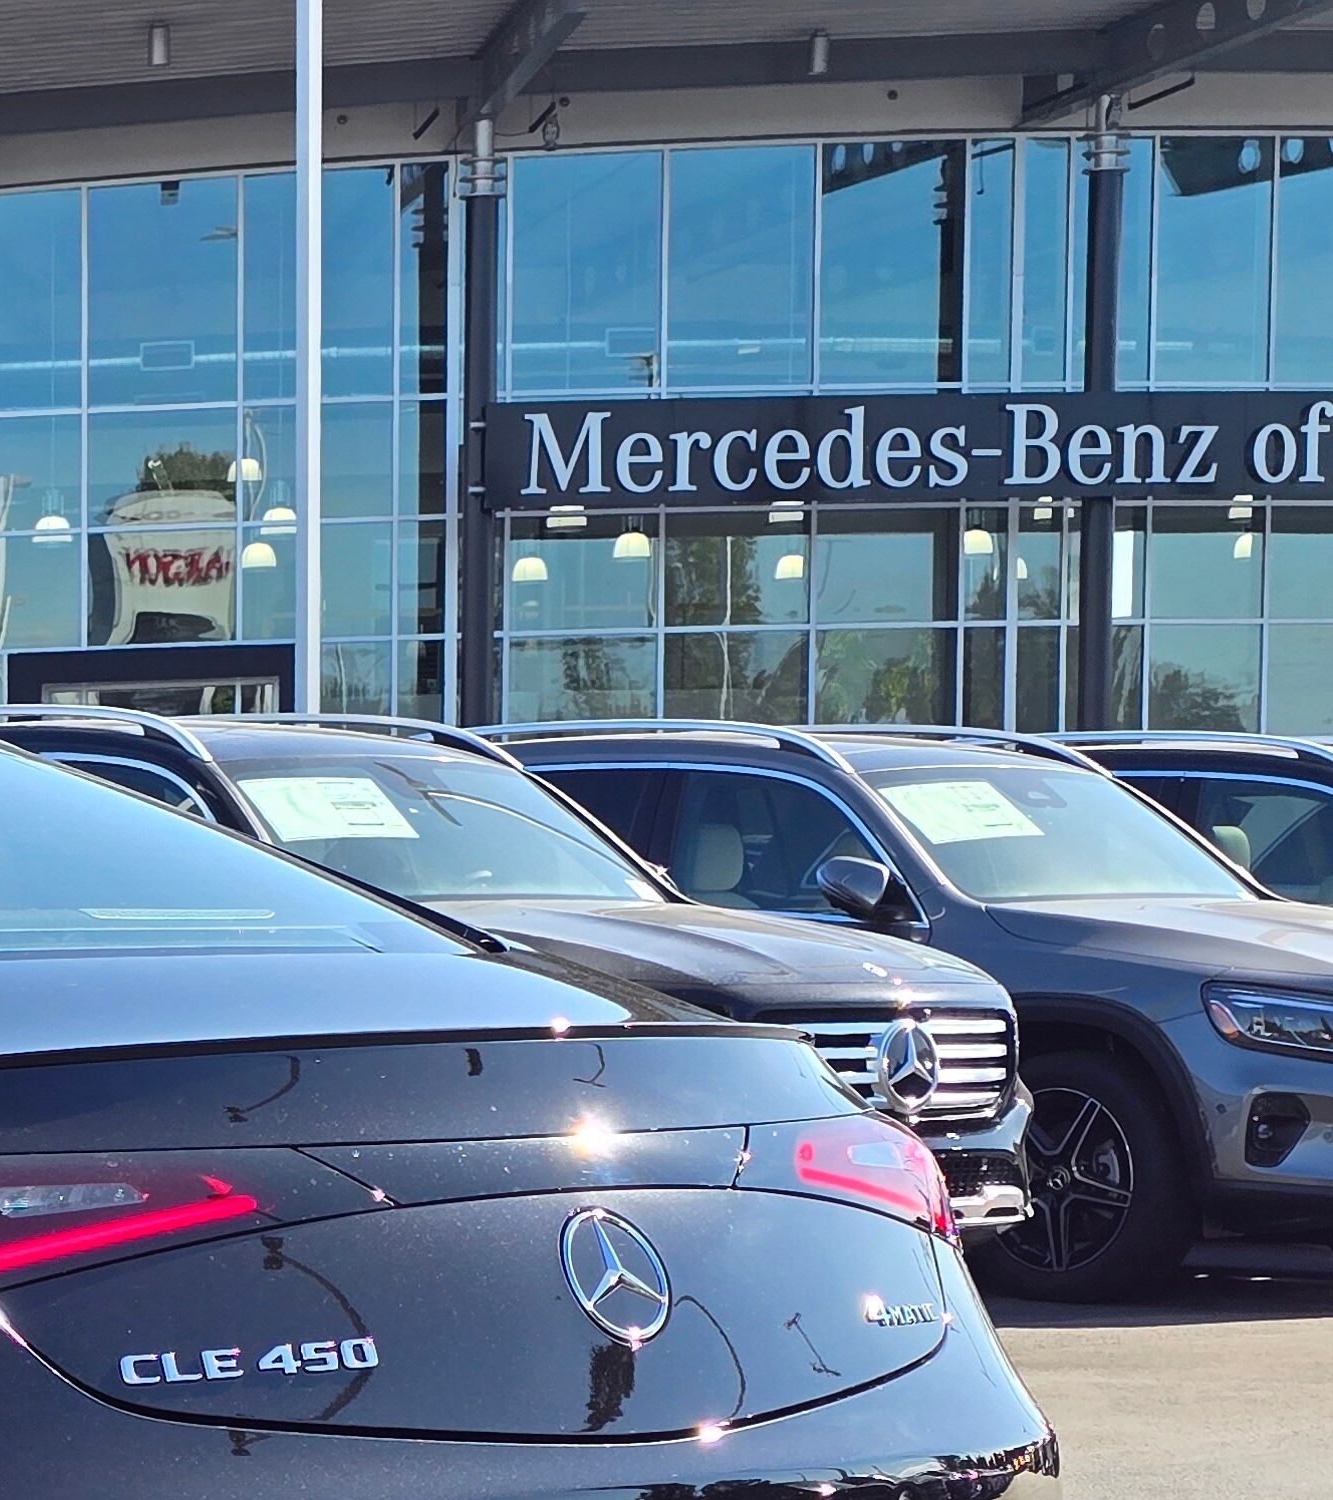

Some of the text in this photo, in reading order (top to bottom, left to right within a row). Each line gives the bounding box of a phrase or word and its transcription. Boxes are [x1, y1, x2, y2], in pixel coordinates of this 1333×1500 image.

[520, 400, 1333, 495] Mercedes-Benz of
[864, 1294, 940, 1327] 4MATIC
[119, 1336, 379, 1385] CLE 450
